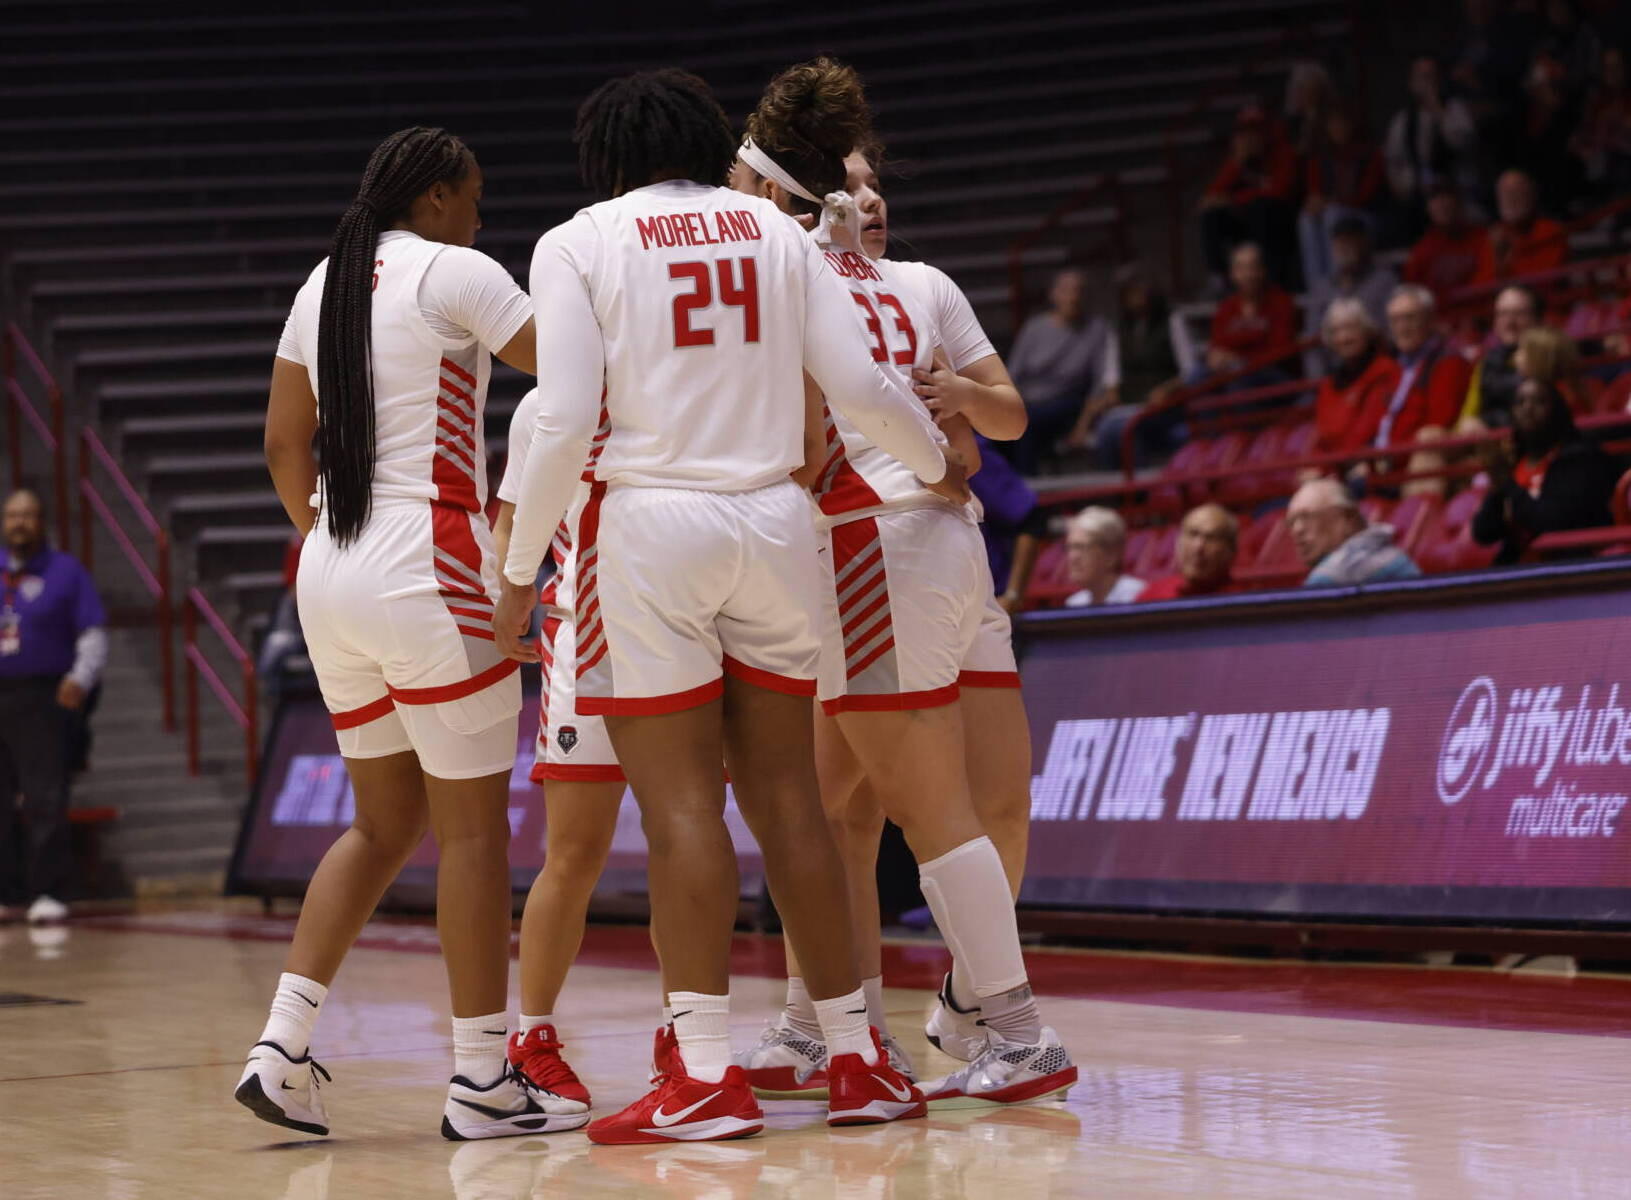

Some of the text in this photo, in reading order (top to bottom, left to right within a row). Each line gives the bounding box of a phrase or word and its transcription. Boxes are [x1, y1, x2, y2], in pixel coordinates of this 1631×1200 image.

[635, 210, 762, 250] MORELAND
[668, 256, 761, 349] 24
[848, 288, 918, 367] 33
[1176, 713, 1271, 820] NEW
[1246, 707, 1392, 820] MEXICO
[1504, 778, 1629, 838] multicare
